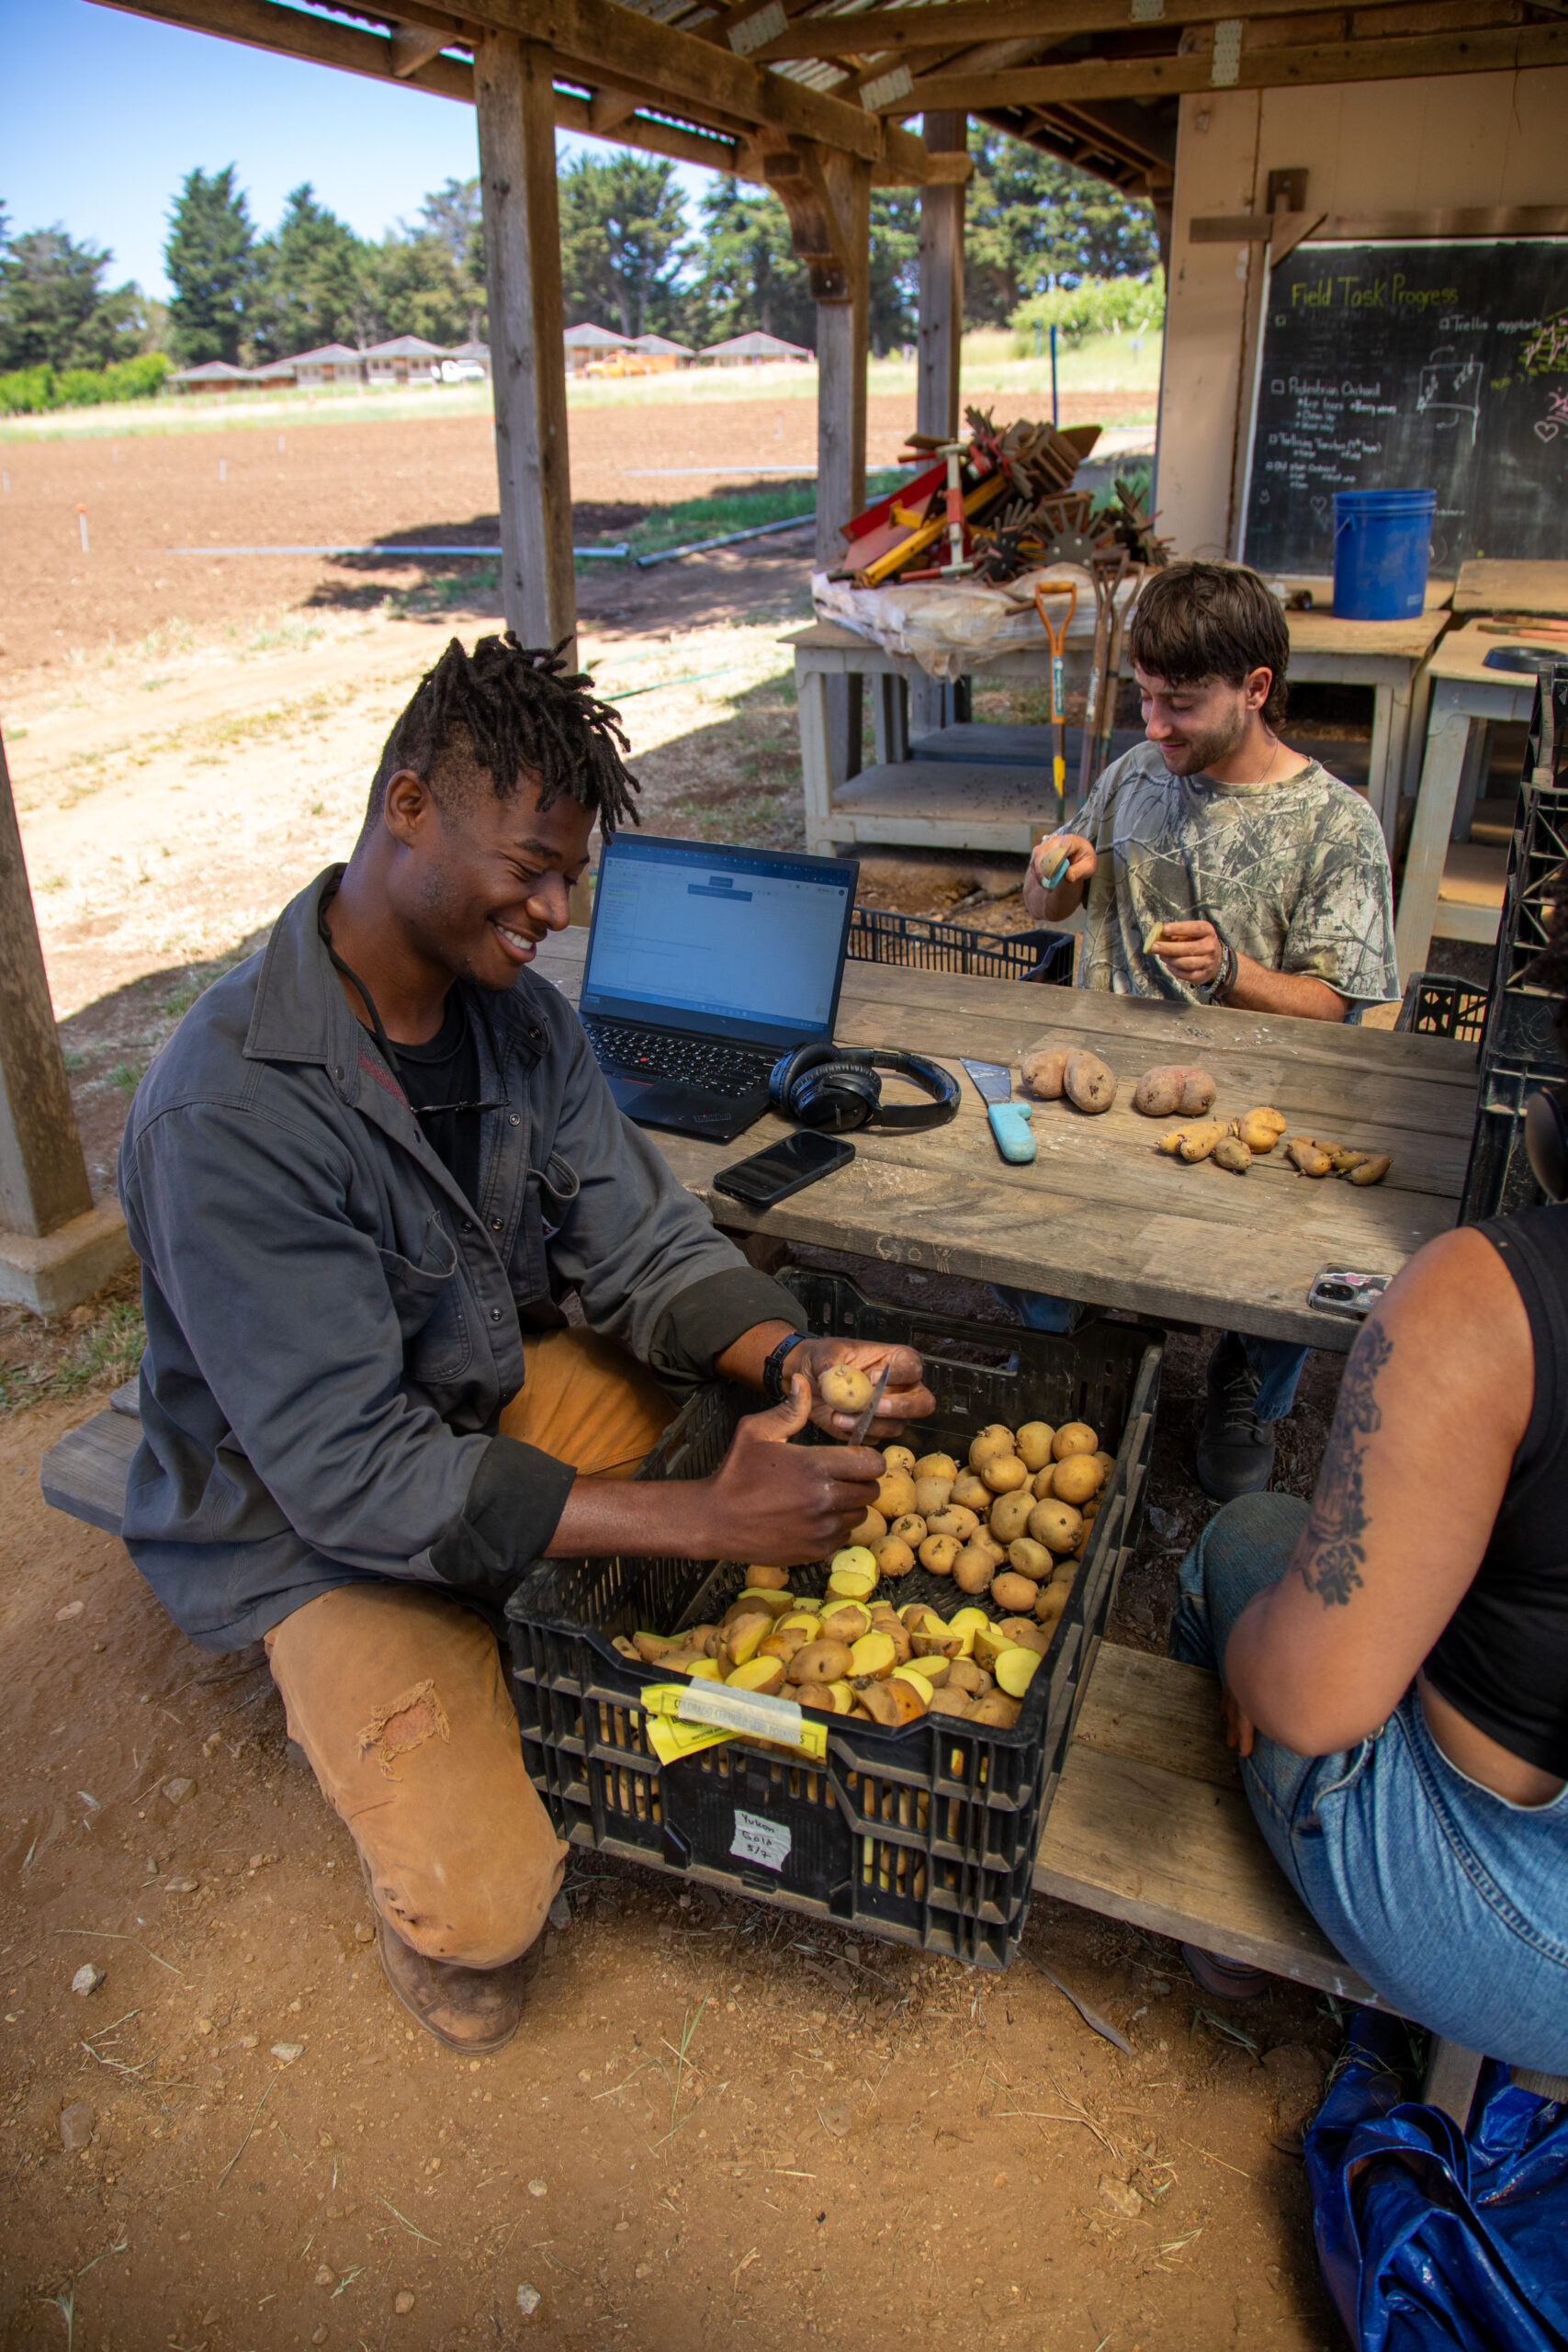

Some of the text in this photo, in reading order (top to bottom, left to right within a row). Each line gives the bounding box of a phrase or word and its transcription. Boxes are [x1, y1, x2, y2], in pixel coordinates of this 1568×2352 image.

[1292, 273, 1459, 313] Field Task Progress
[741, 1813, 774, 1833] Yukon
[742, 1830, 772, 1846] Gold
[748, 1844, 772, 1858] 5/7
